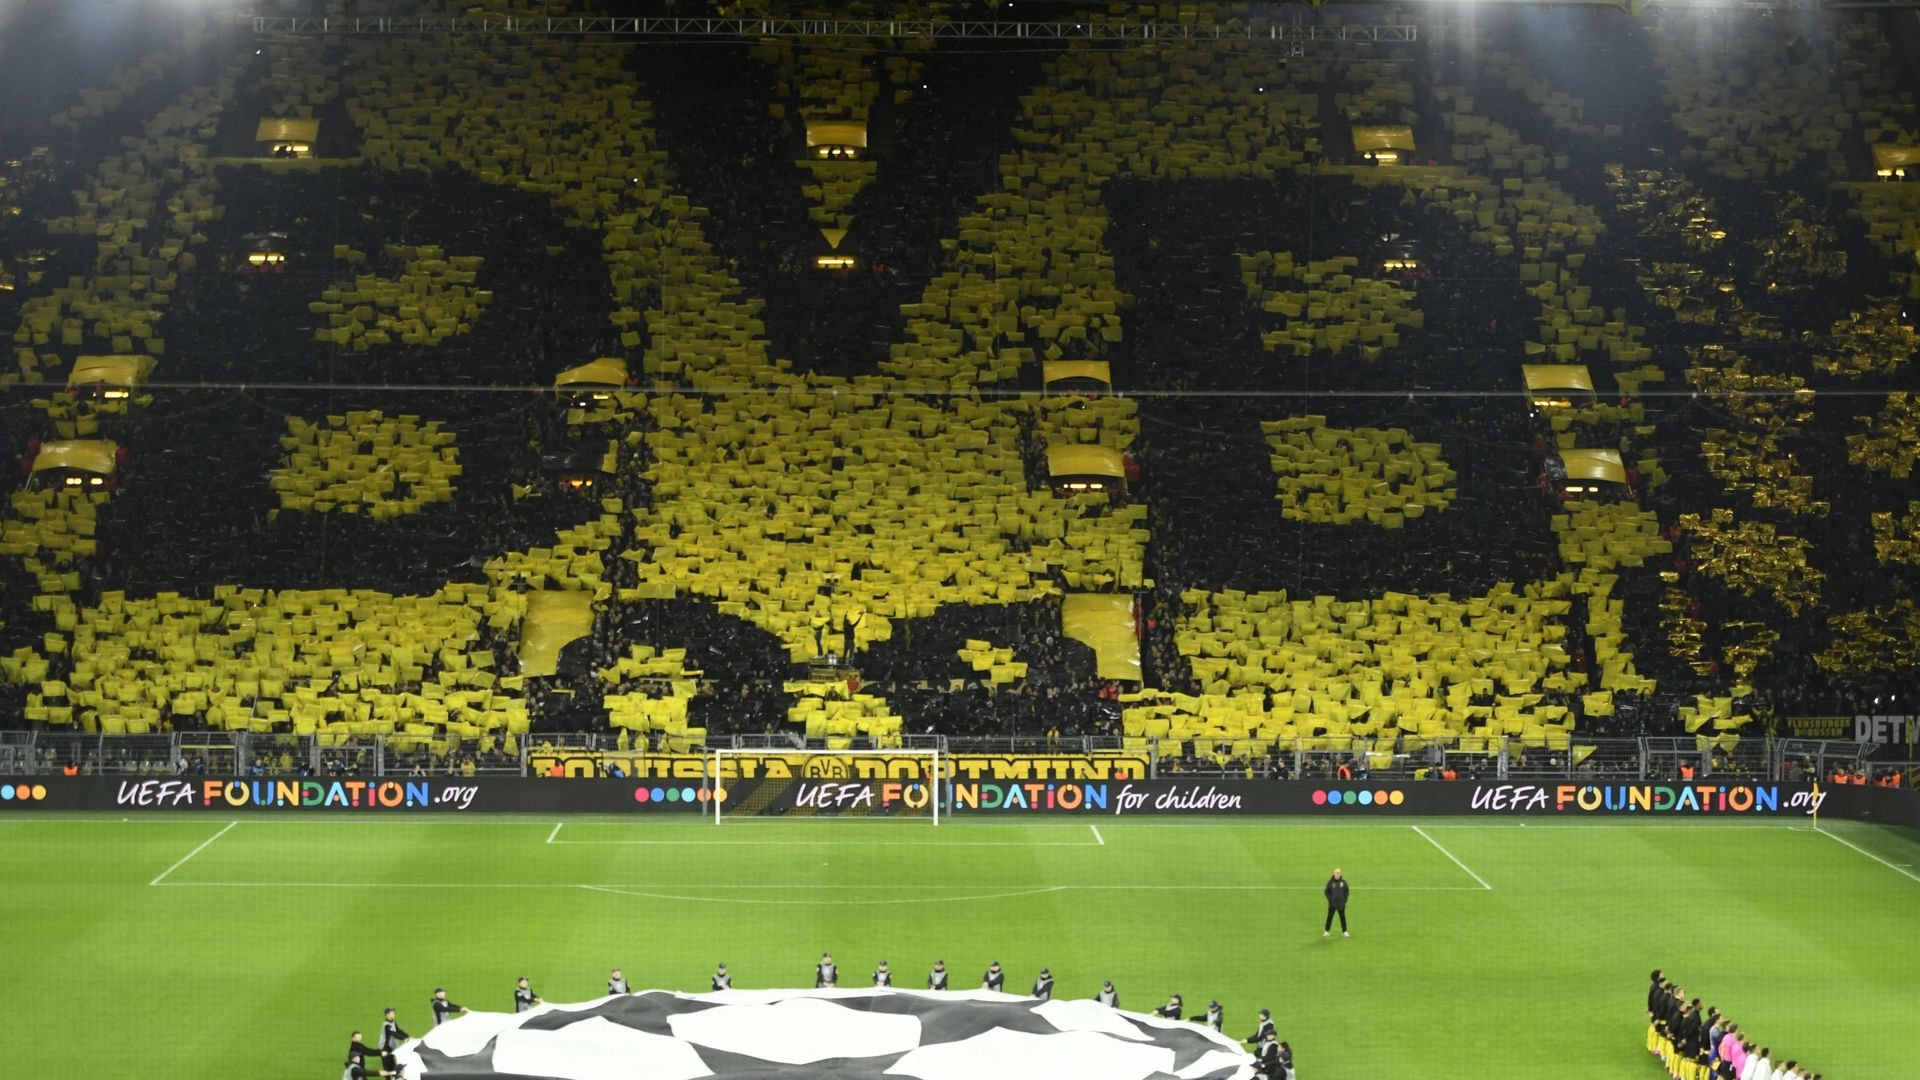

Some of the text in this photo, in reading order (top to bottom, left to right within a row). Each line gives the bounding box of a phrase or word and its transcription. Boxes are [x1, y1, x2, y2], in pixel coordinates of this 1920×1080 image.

[116, 780, 197, 806] UEFA
[434, 785, 478, 810] .org
[795, 783, 875, 808] UEFA
[1115, 783, 1149, 815] for
[1155, 785, 1242, 810] children
[1471, 785, 1549, 810] UEFA
[1783, 790, 1826, 815] .org
